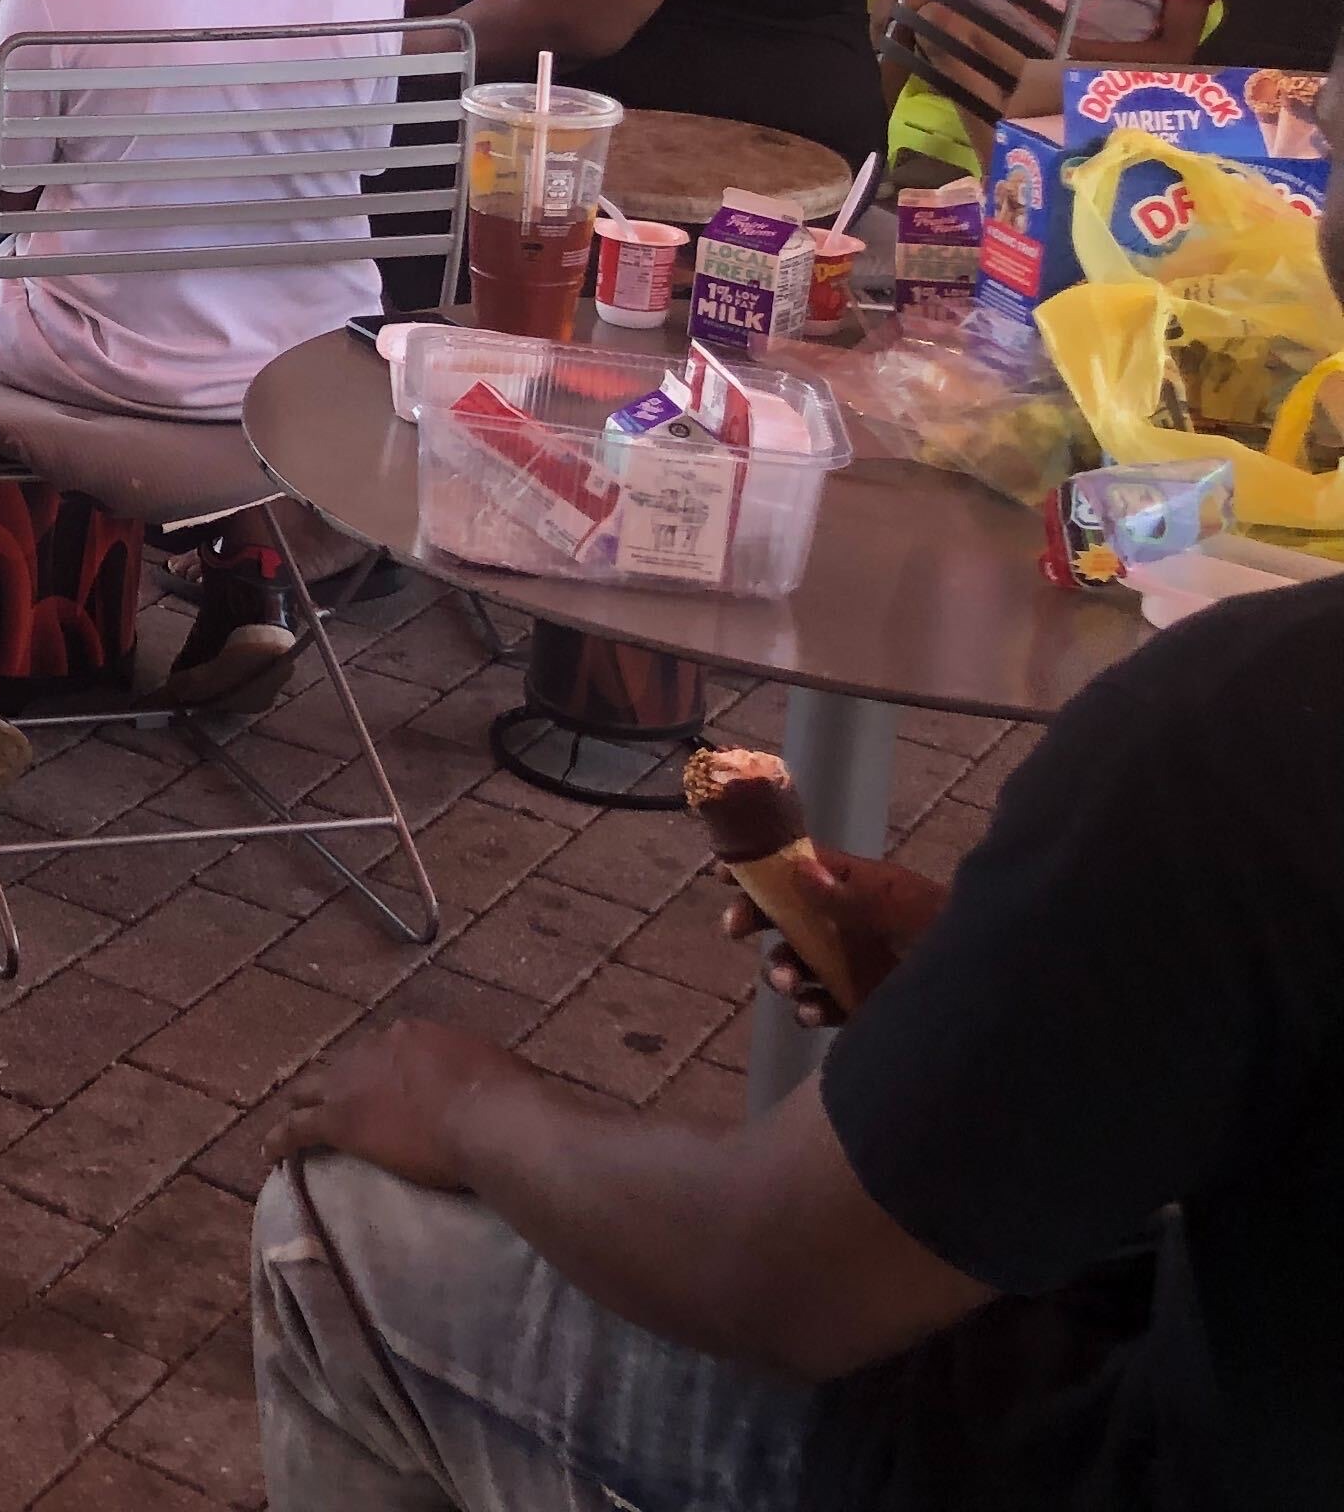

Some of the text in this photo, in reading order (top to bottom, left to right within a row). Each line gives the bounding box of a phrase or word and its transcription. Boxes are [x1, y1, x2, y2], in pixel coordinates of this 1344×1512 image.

[1113, 109, 1201, 131] VARIETY
[706, 239, 774, 270] LOCAL
[703, 258, 773, 287] FRESH
[707, 282, 761, 304] 1% LOW
[734, 298, 757, 311] FAT
[697, 296, 765, 332] MILK
